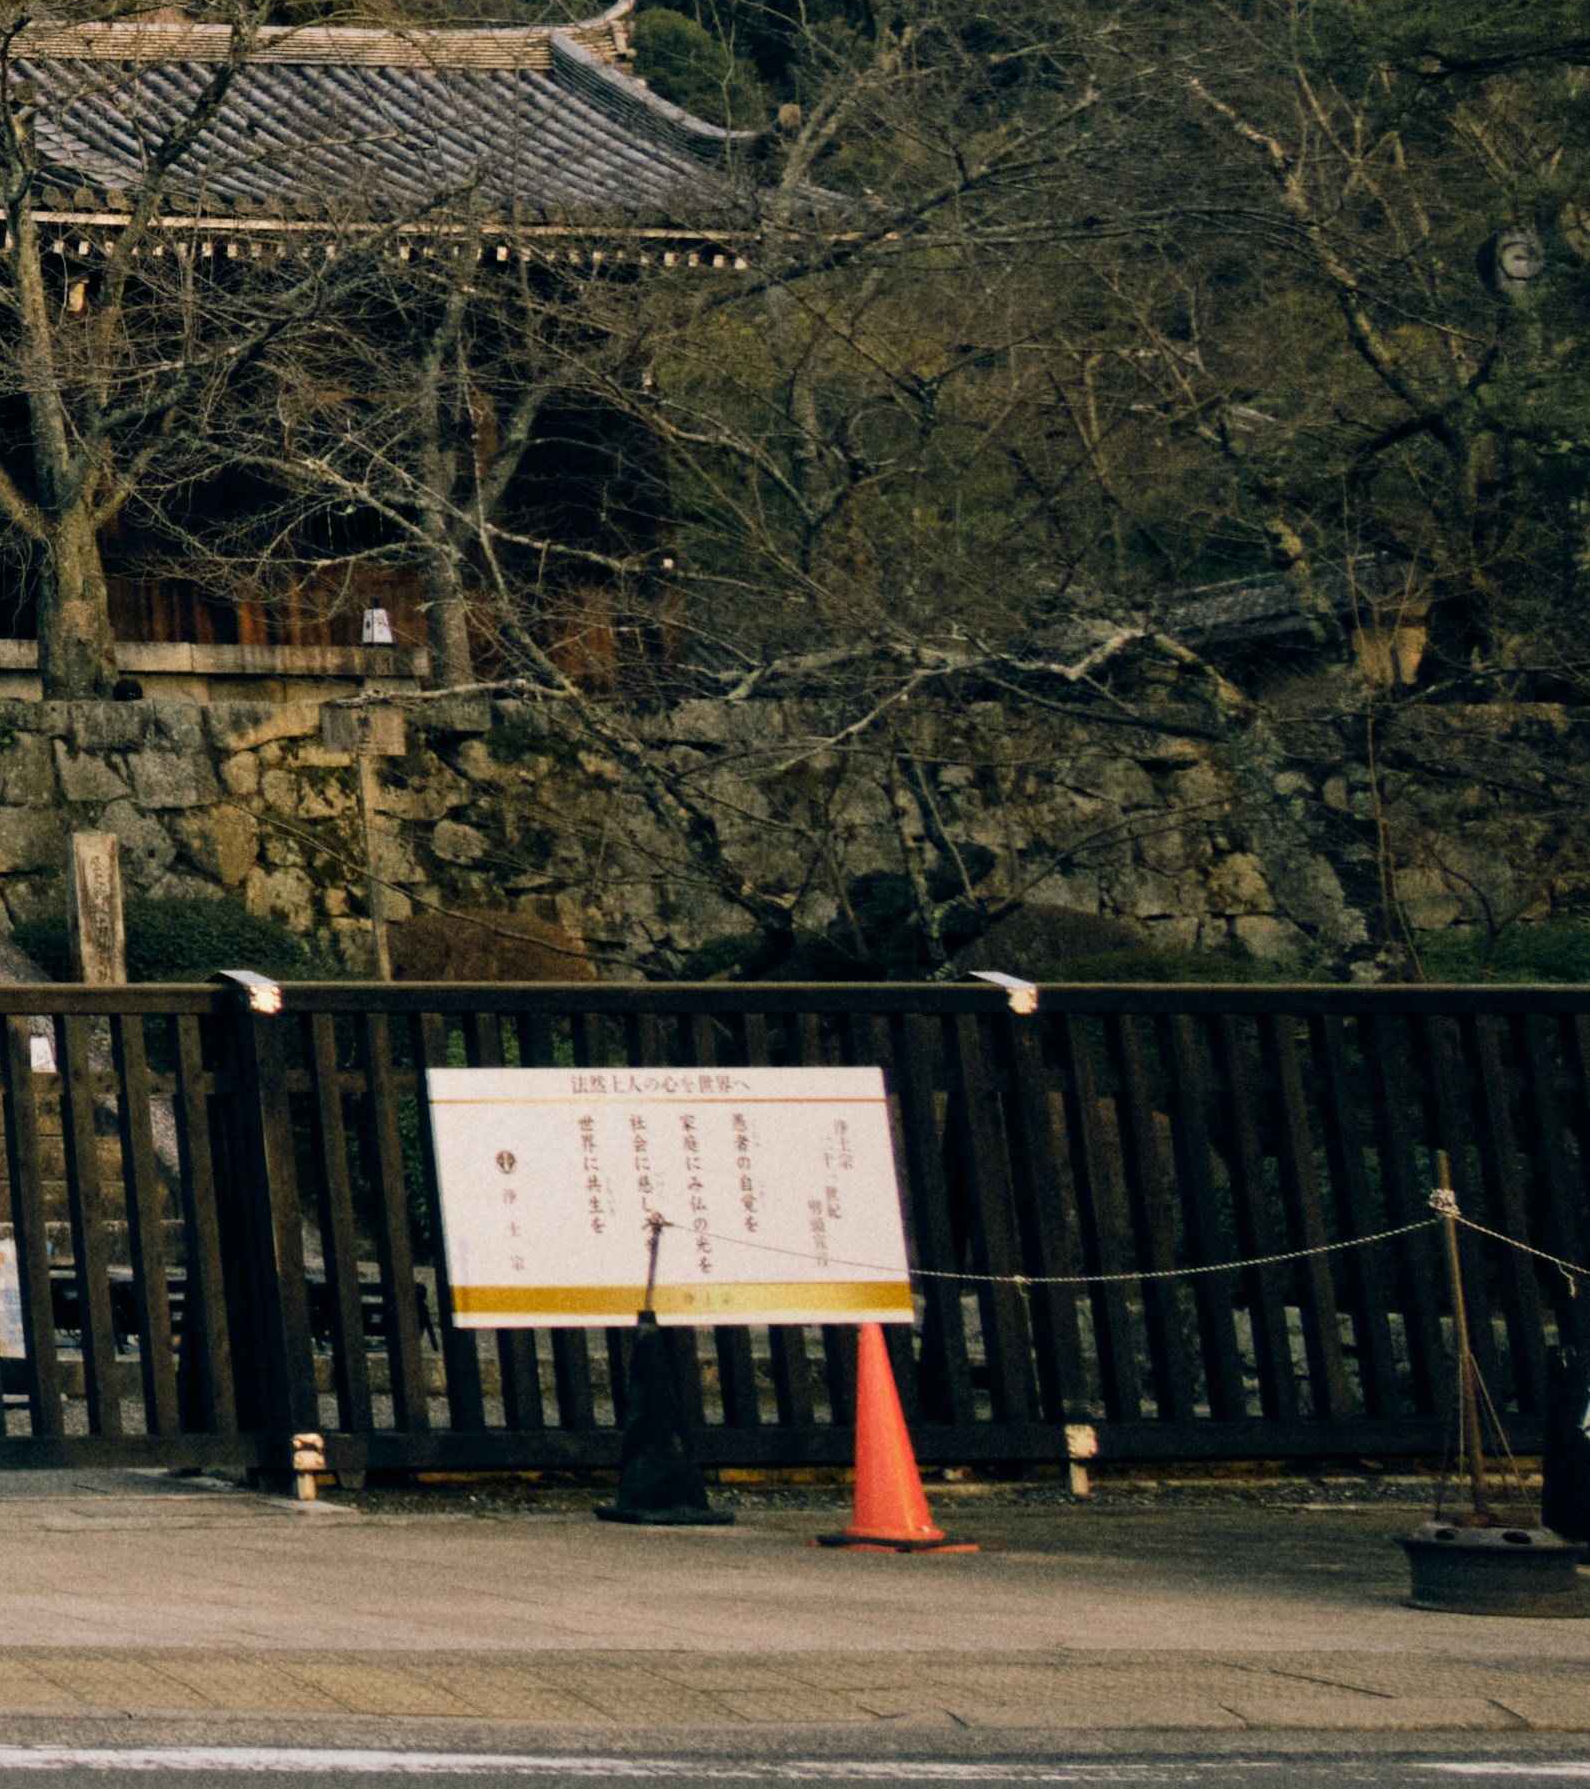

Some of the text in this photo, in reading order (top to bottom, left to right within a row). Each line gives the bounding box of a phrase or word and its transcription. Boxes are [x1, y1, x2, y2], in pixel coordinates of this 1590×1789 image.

[570, 1074, 752, 1094] 法然上人の心を世界へ
[577, 1114, 607, 1235] 世界に共生を
[678, 1113, 714, 1275] 家庭にみ仏の光を
[732, 1112, 759, 1233] 愚者の自覚を
